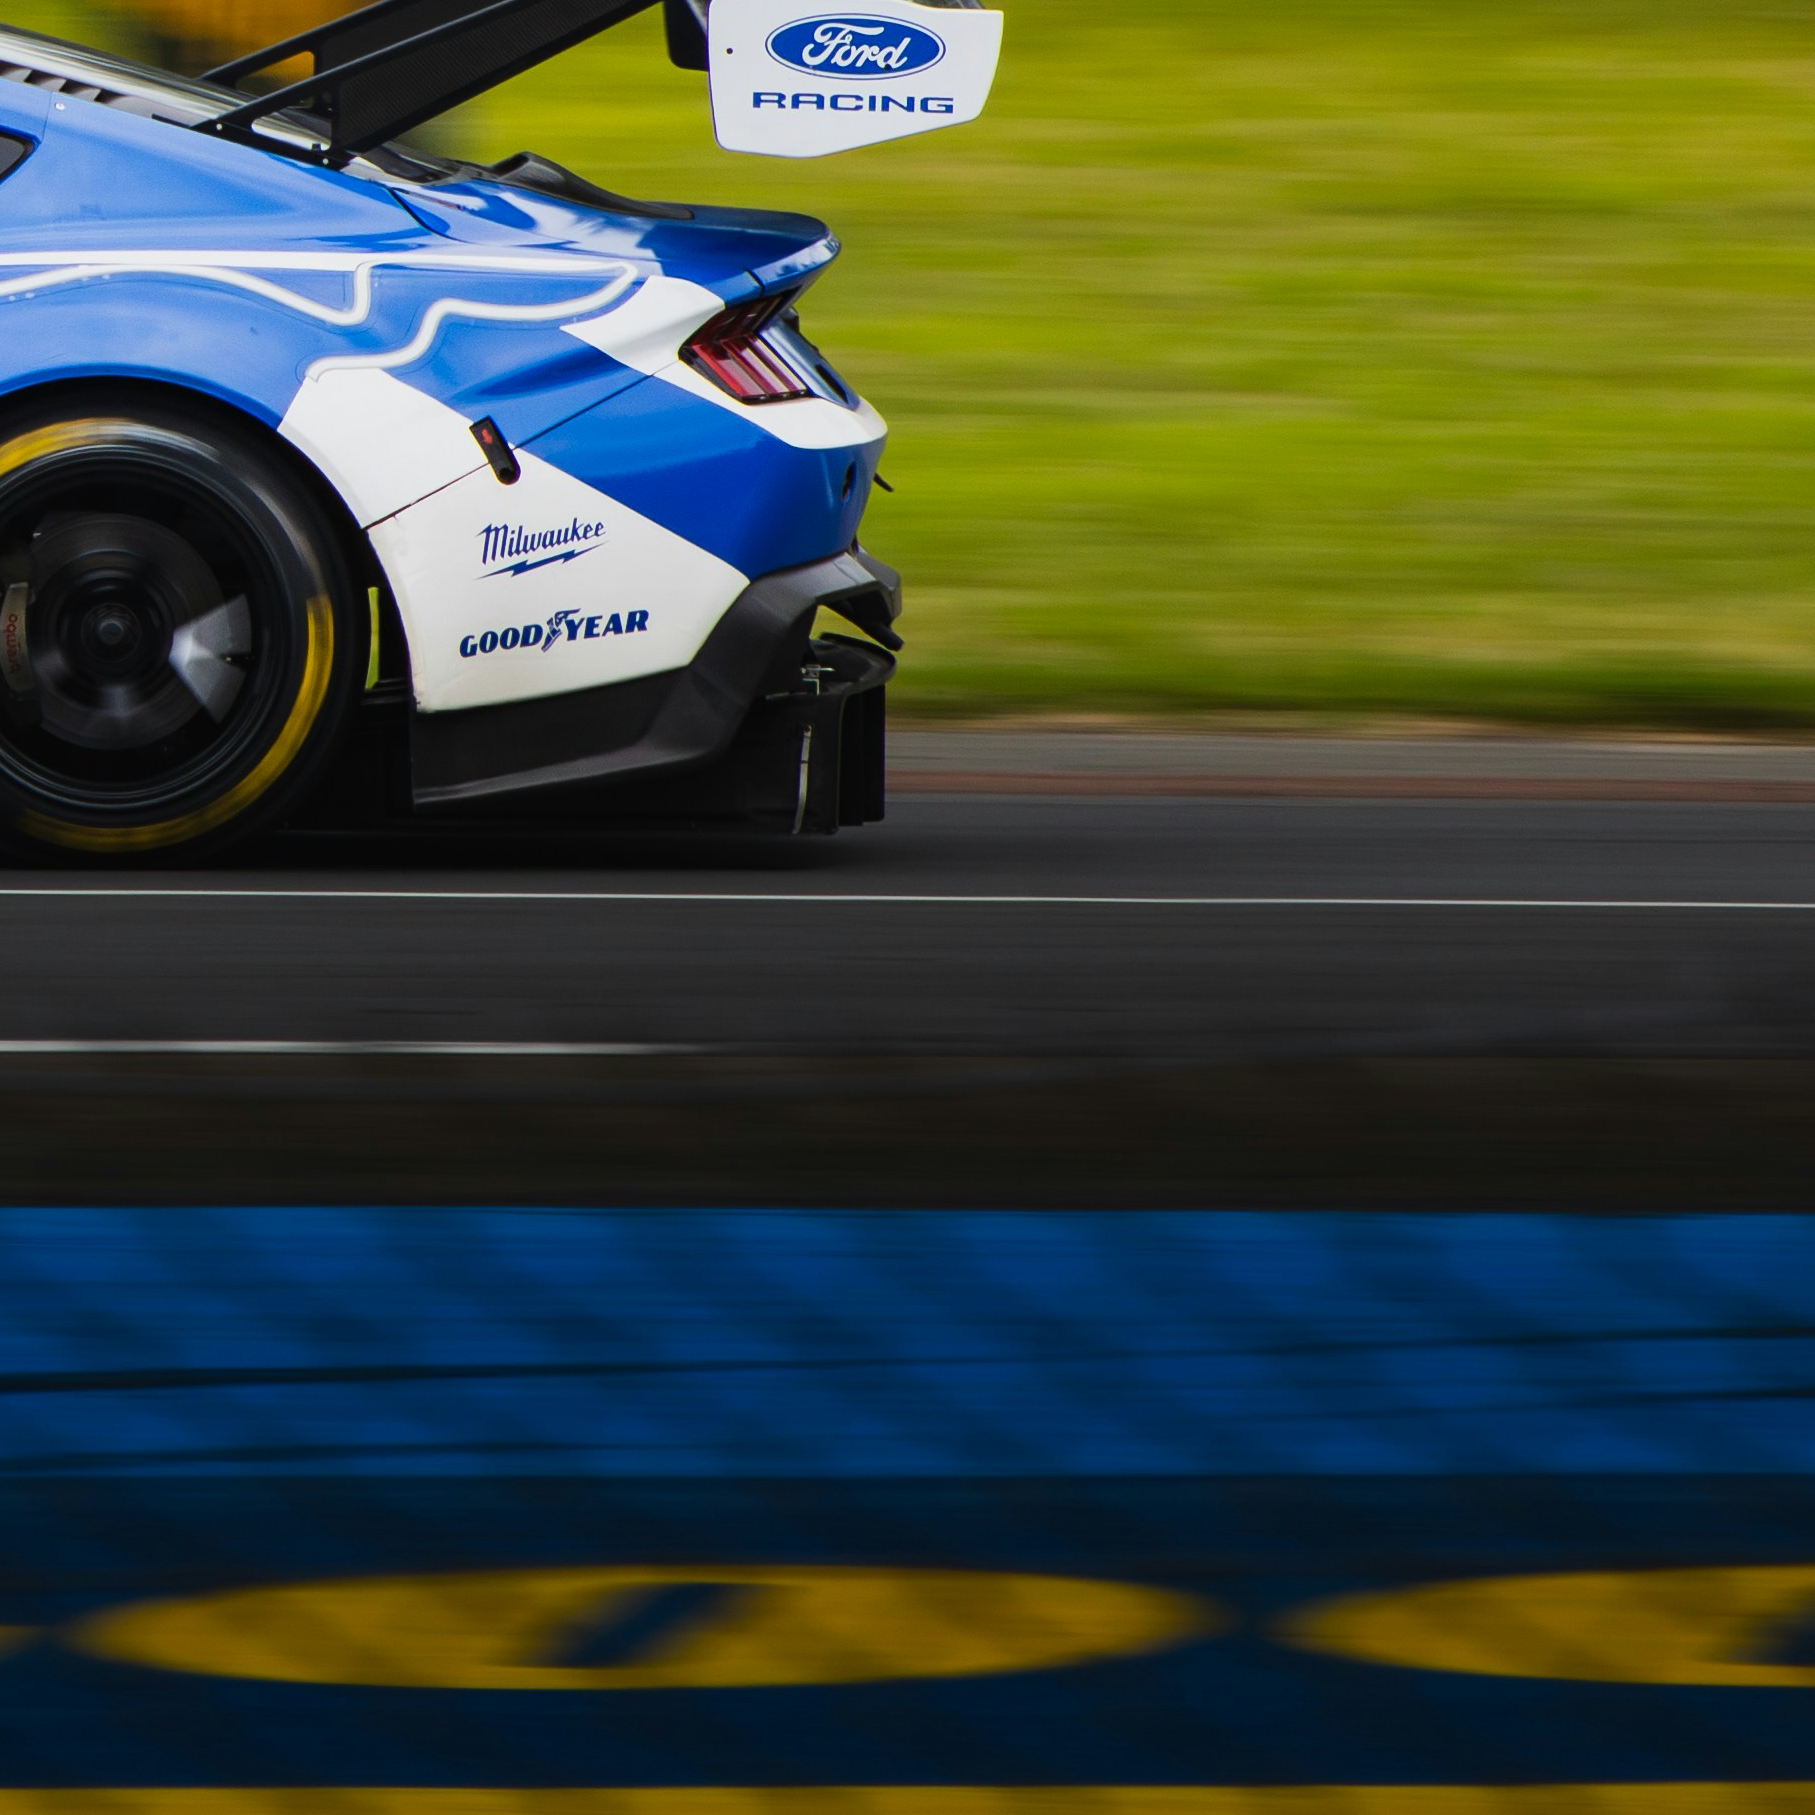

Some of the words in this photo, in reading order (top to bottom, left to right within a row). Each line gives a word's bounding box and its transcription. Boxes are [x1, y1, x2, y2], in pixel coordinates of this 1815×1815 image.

[801, 22, 912, 70] Ford
[752, 92, 954, 114] RACING
[476, 517, 607, 566] Milwaukee
[459, 609, 650, 658] GOODYEAR
